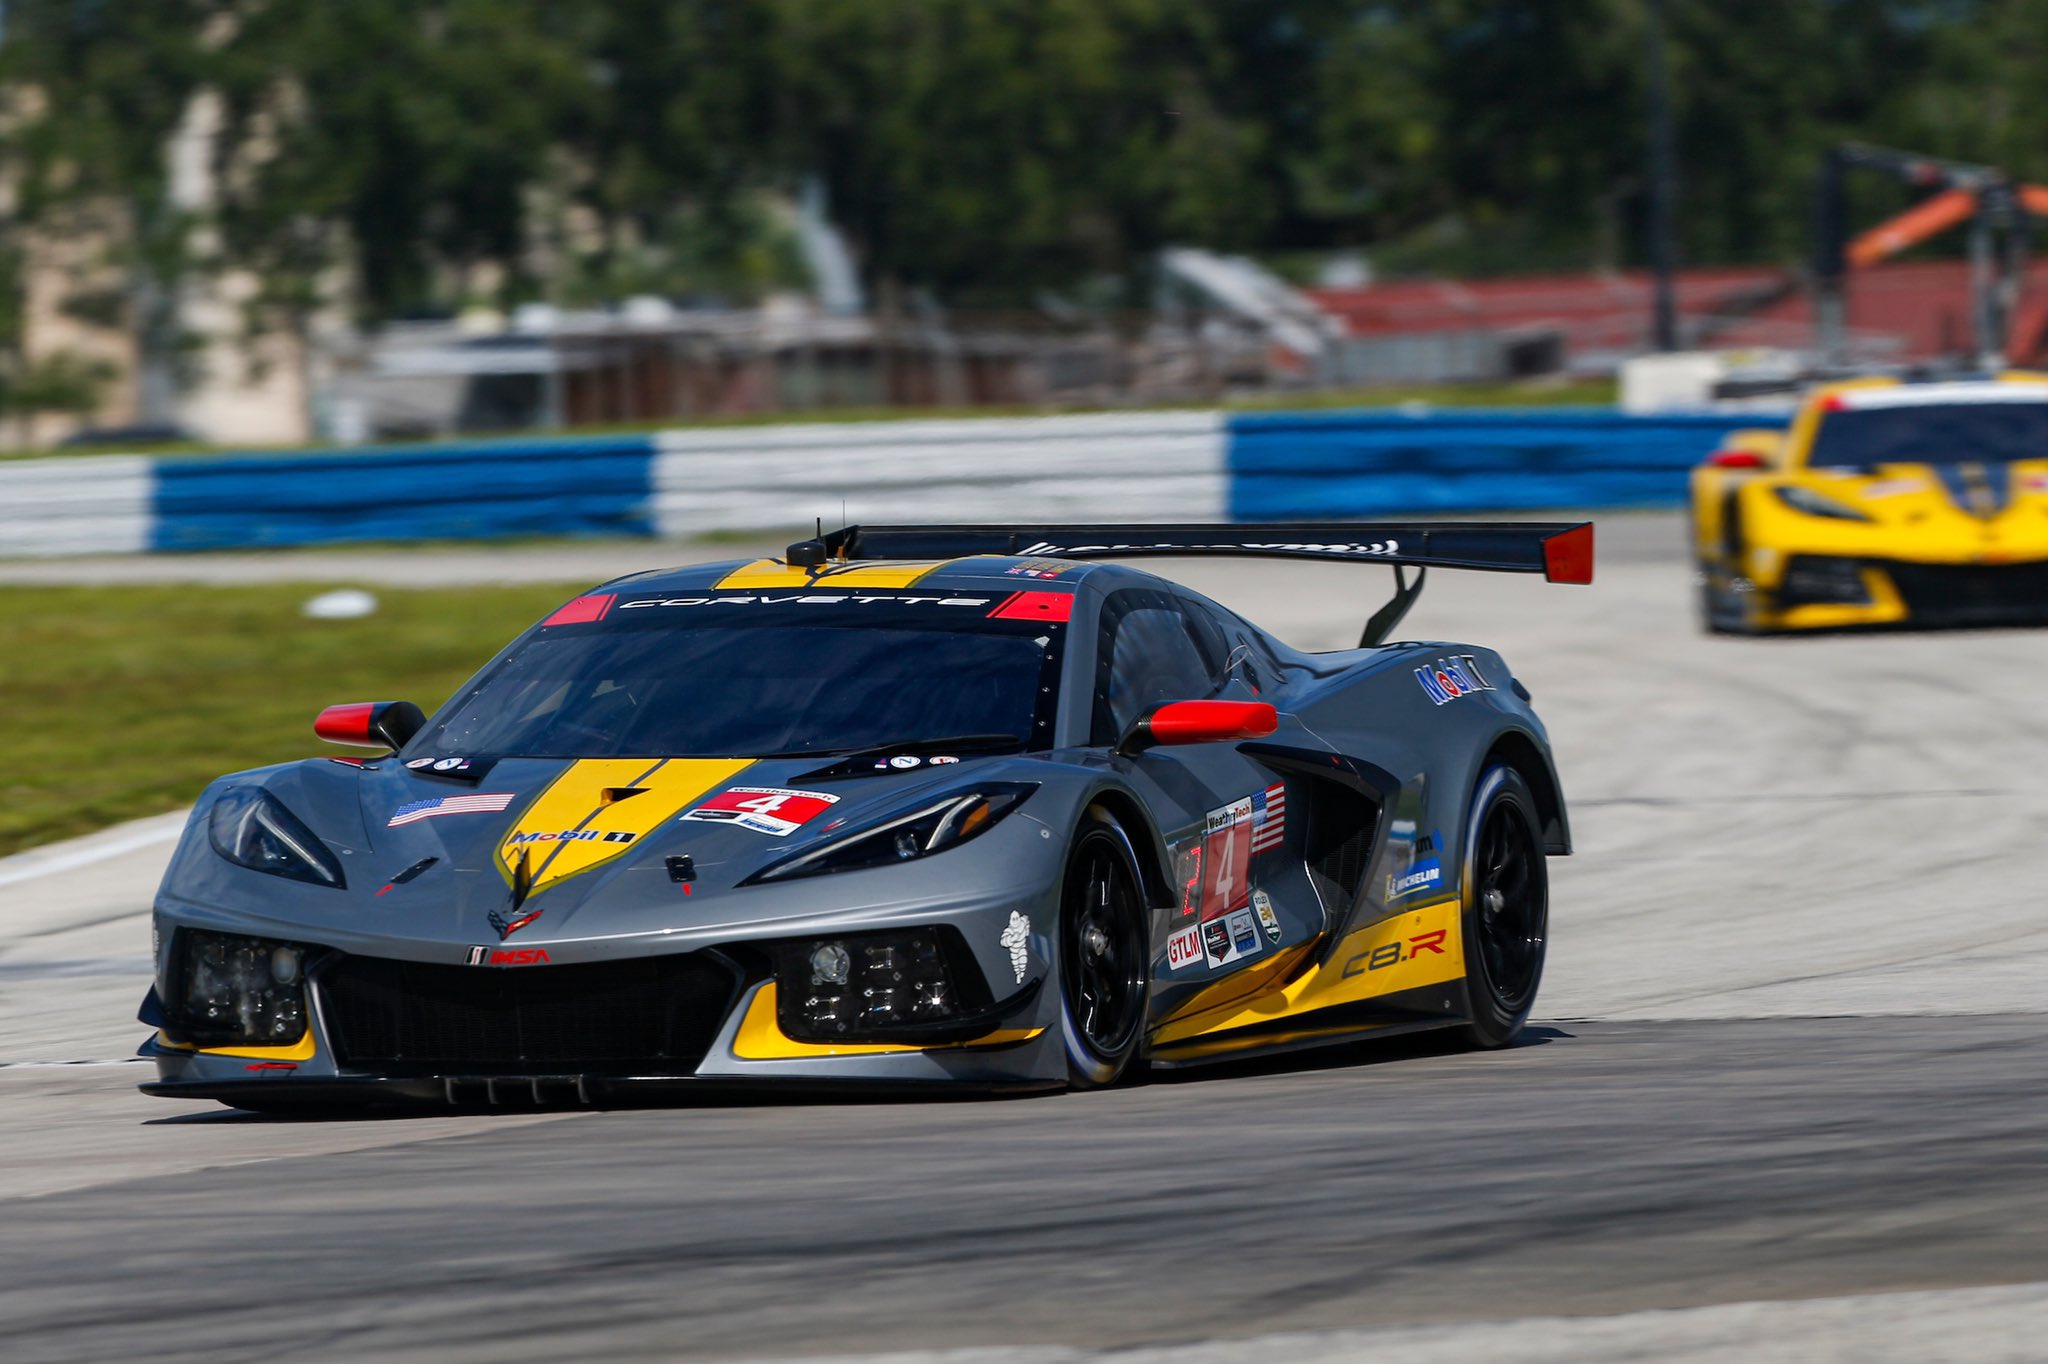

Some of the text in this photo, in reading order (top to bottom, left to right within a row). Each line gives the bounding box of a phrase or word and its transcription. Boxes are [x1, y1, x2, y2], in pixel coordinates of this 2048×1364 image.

[619, 595, 991, 609] CORVETTE
[1413, 656, 1482, 705] Mobil
[736, 795, 793, 814] 4
[510, 830, 600, 844] Mobil
[1214, 829, 1236, 909] 4
[1396, 868, 1440, 892] MICHELIN
[489, 948, 551, 965] IMSA
[1168, 930, 1201, 964] GTLM
[1342, 929, 1447, 979] C8.R
